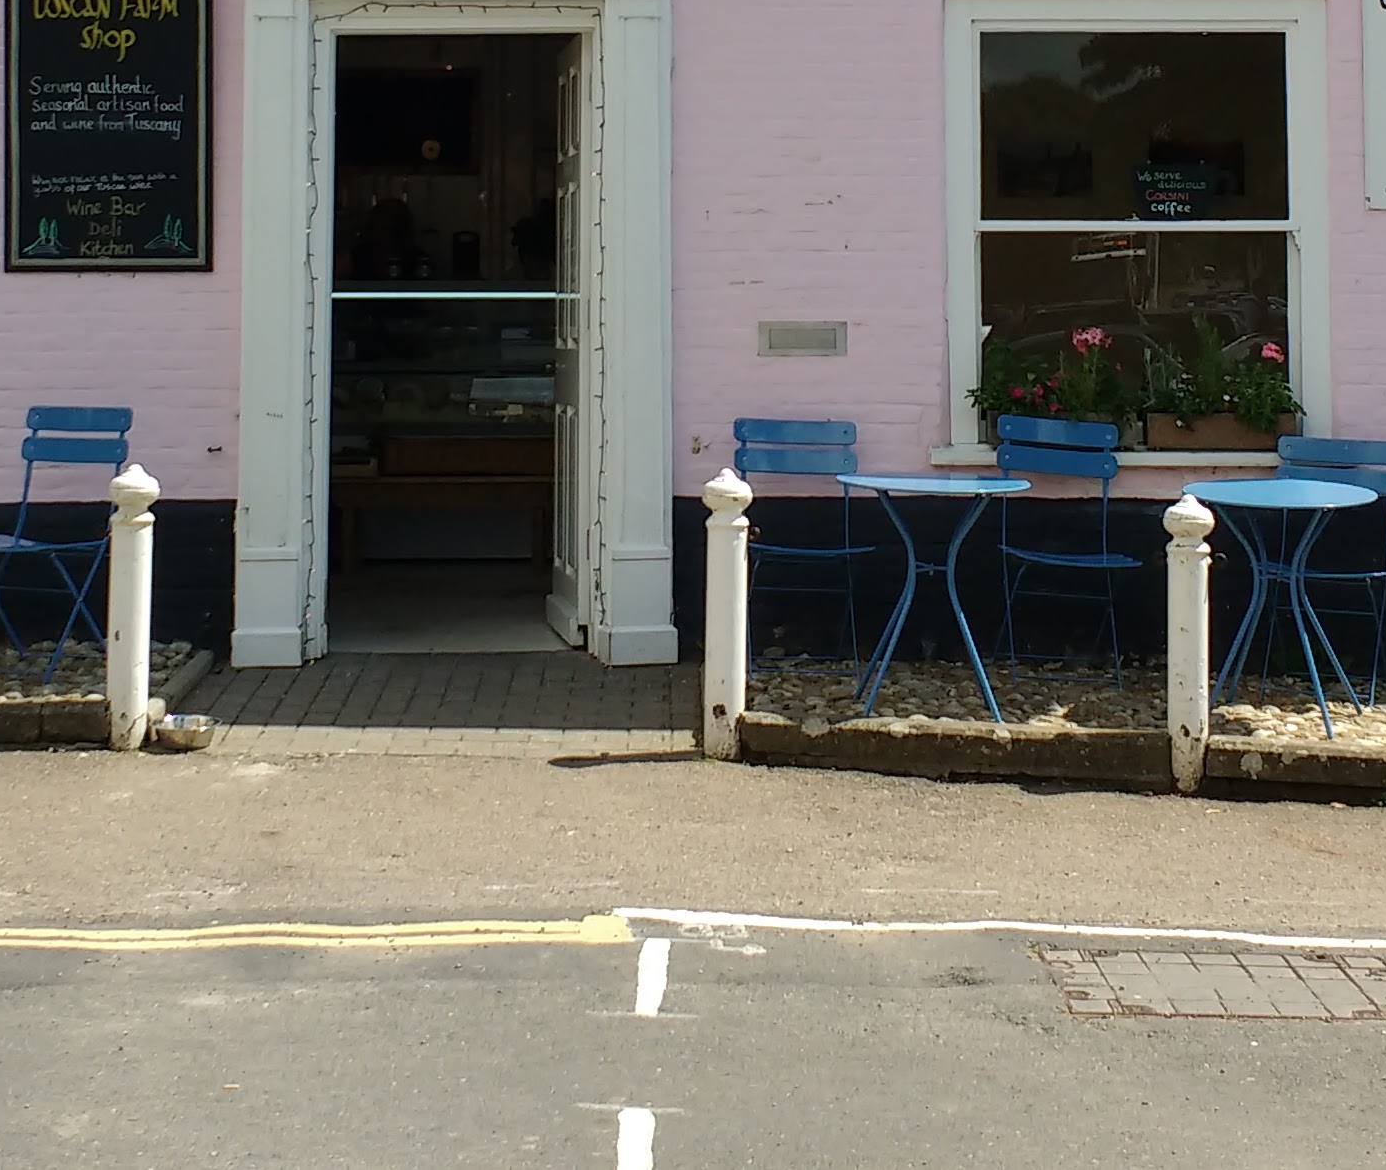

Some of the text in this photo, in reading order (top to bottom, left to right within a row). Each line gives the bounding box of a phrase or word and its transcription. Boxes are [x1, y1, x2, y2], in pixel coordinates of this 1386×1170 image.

[29, 73, 154, 101] Serving authentic
[96, 95, 151, 113] artisan
[154, 94, 184, 113] food
[30, 112, 183, 141] and wine from Tuscany
[1136, 170, 1183, 182] We serve
[64, 184, 76, 195] of
[1157, 181, 1206, 190] delicious
[66, 195, 147, 216] Wine Bar
[1150, 201, 1192, 217] coffee
[88, 217, 122, 237] Deli
[80, 240, 134, 257] Kitchen
